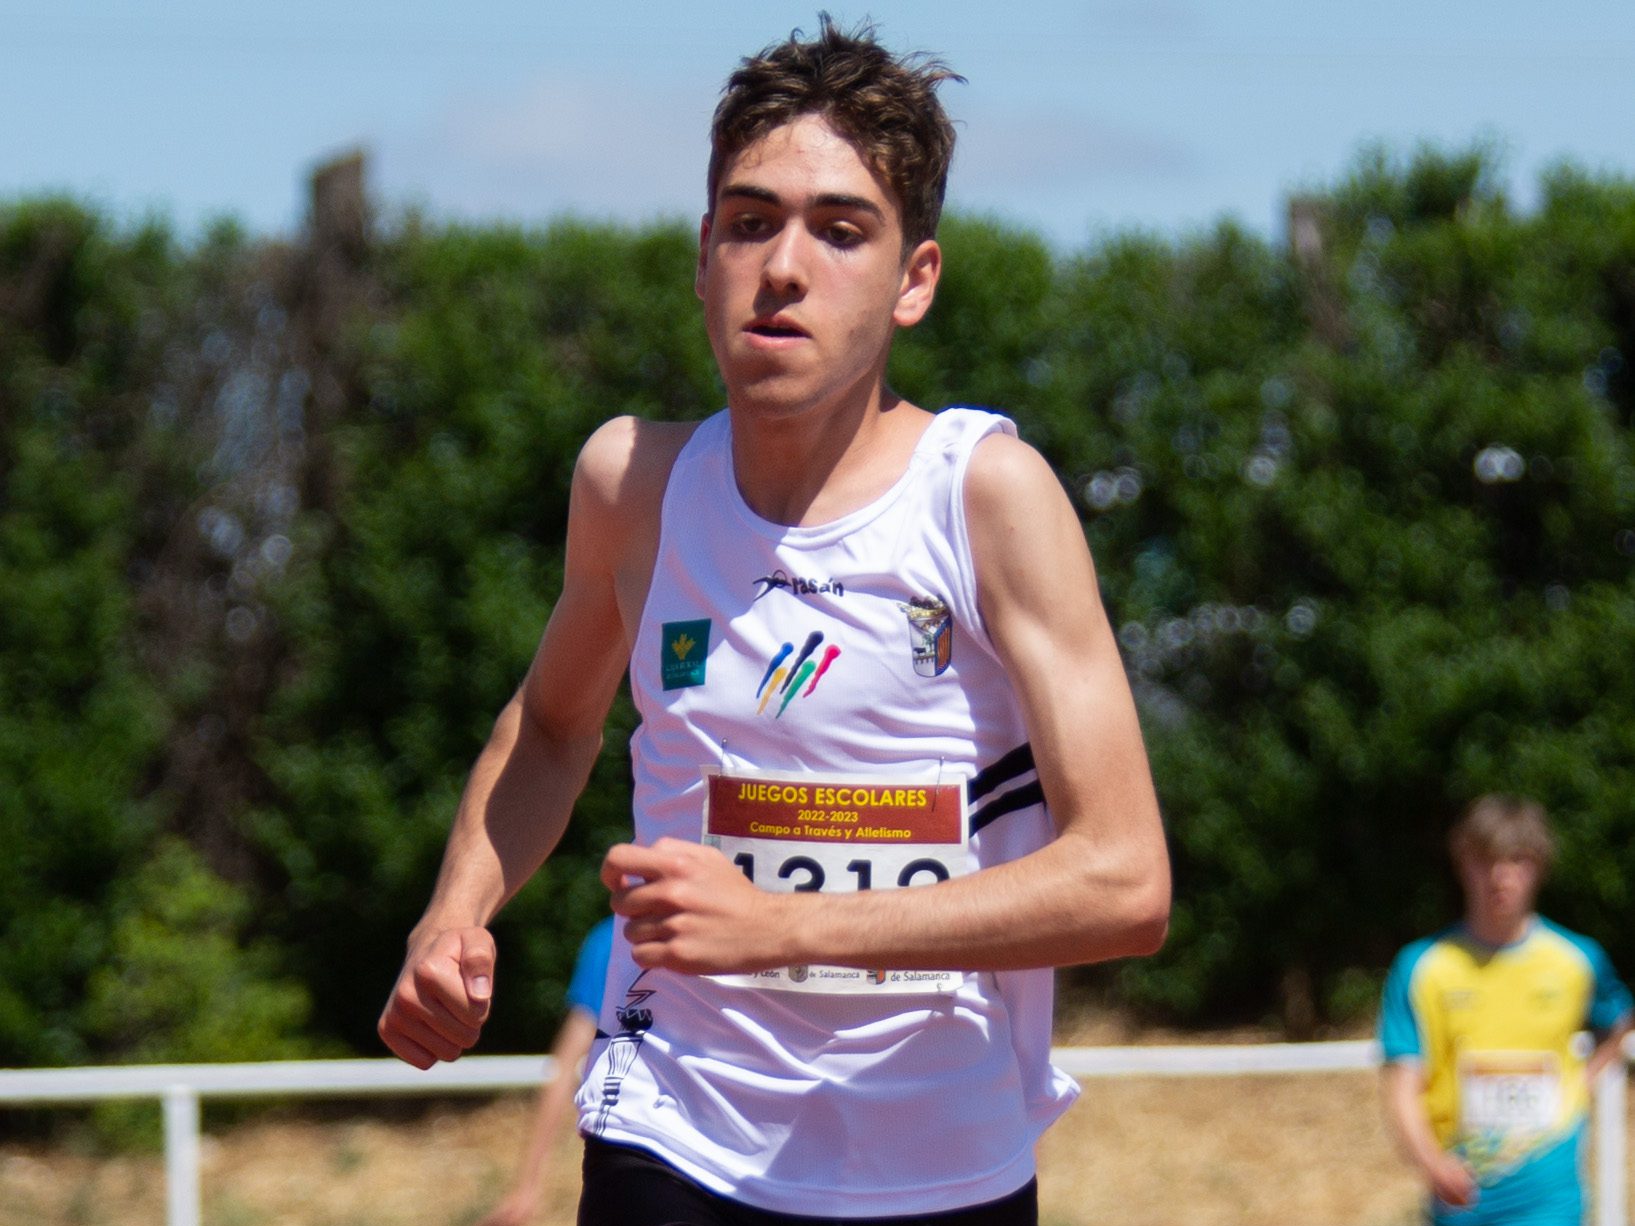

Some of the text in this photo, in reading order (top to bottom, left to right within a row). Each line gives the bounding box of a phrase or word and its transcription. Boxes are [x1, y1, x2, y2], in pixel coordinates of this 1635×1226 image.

[738, 783, 926, 808] JUEGOS ESCOLARES
[798, 809, 859, 823] 2022-2023
[750, 821, 912, 840] Campo a Través y Atletismo
[819, 969, 860, 979] Salamanca
[890, 971, 951, 982] de Salamanca
